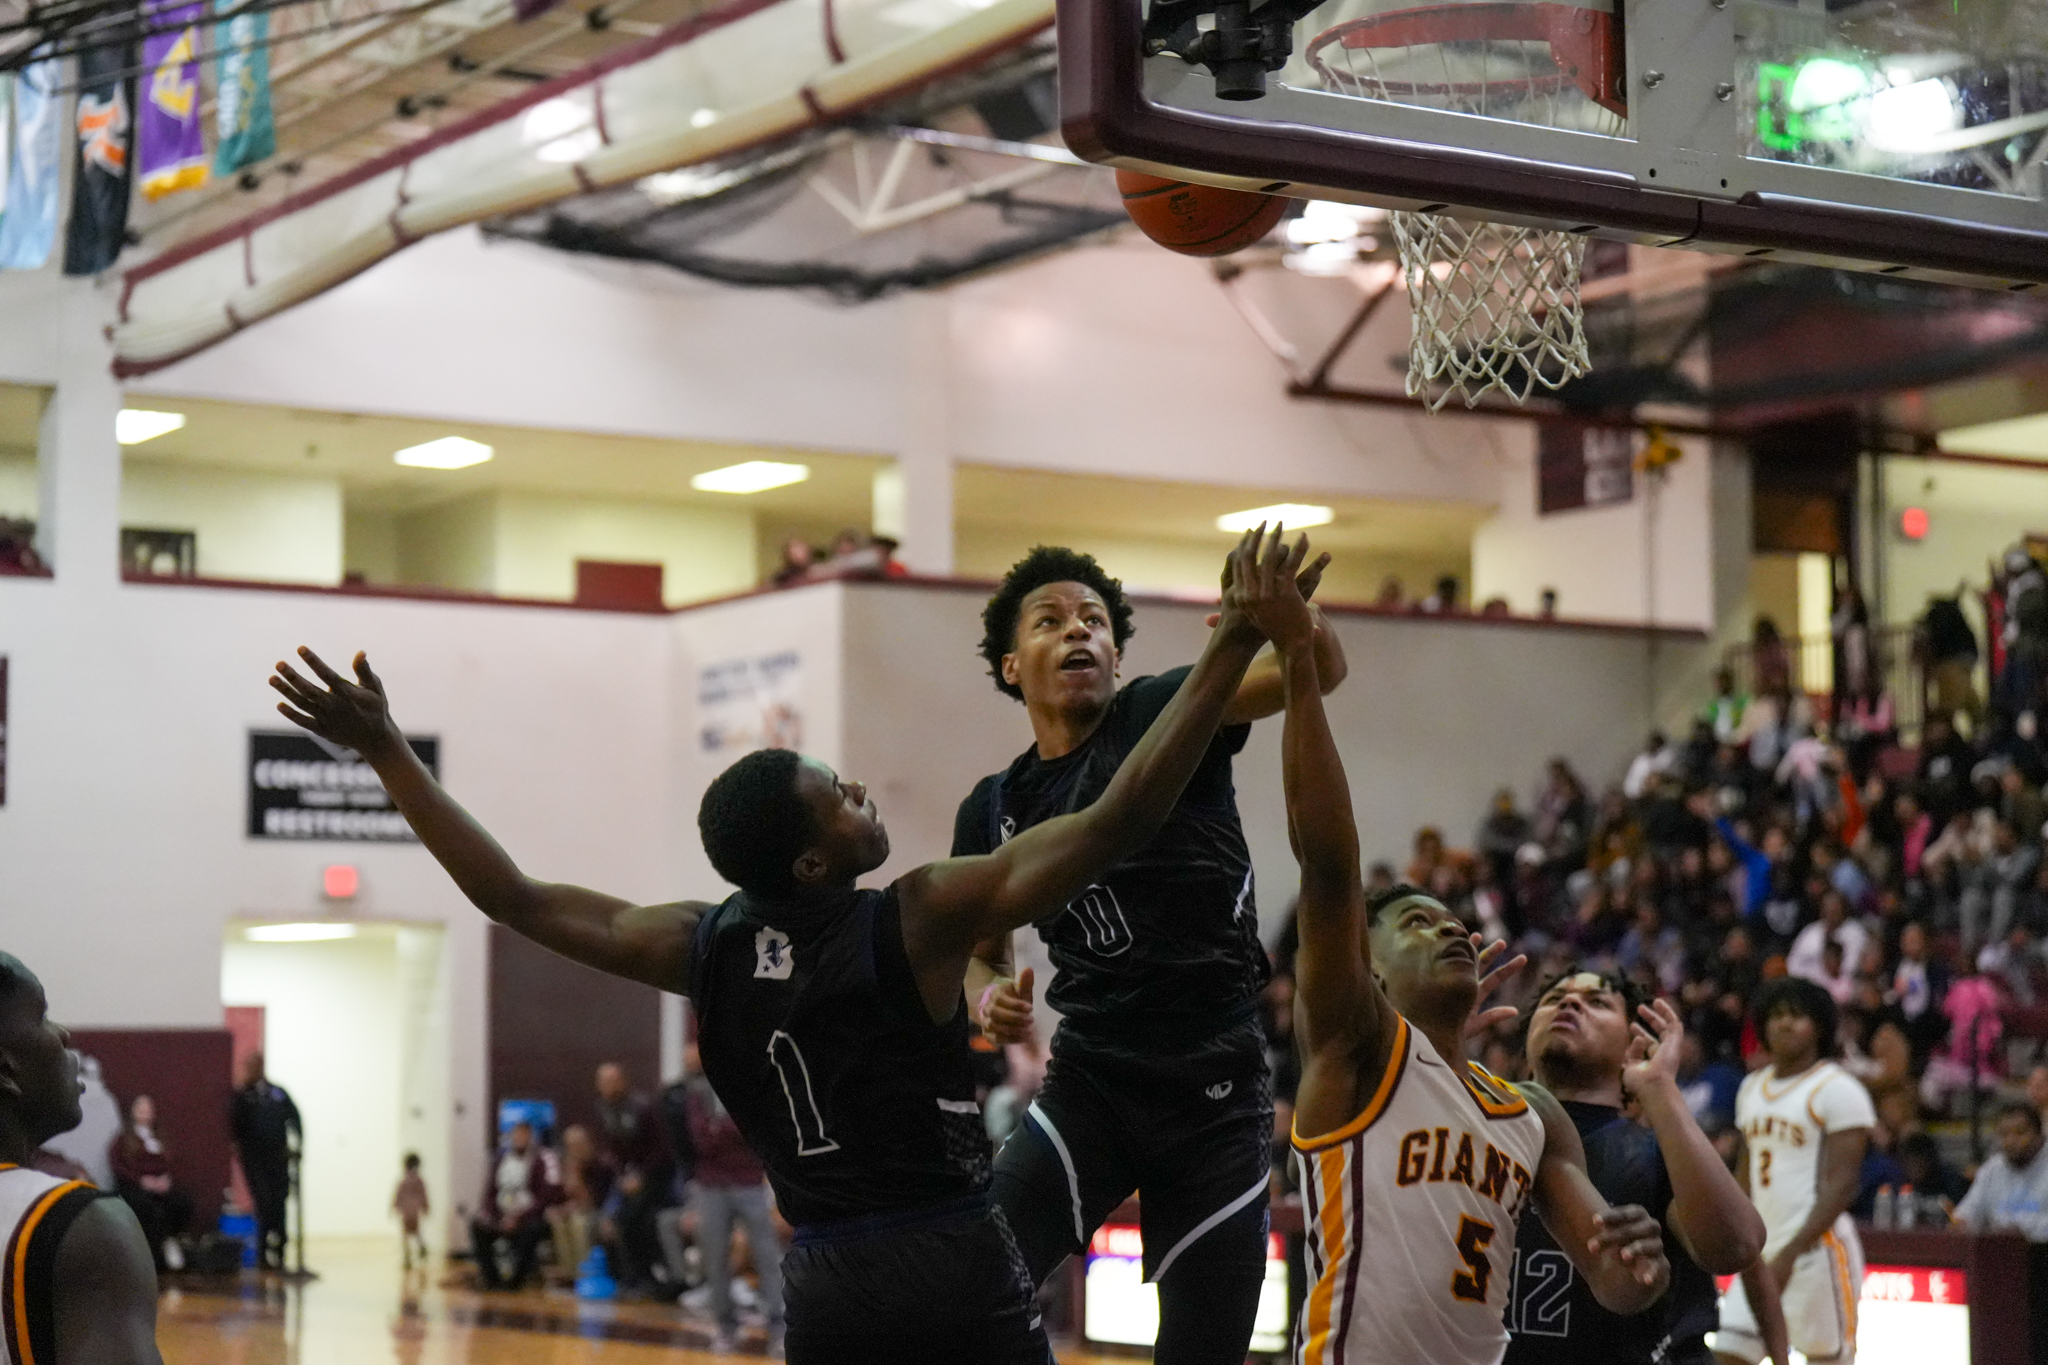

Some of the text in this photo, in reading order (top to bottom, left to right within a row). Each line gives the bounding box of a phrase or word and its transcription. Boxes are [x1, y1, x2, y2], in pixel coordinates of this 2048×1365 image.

[766, 1029, 841, 1157] 1
[1396, 1126, 1532, 1217] GIANT
[1760, 1149, 1772, 1188] 2
[1450, 1212, 1495, 1304] 5
